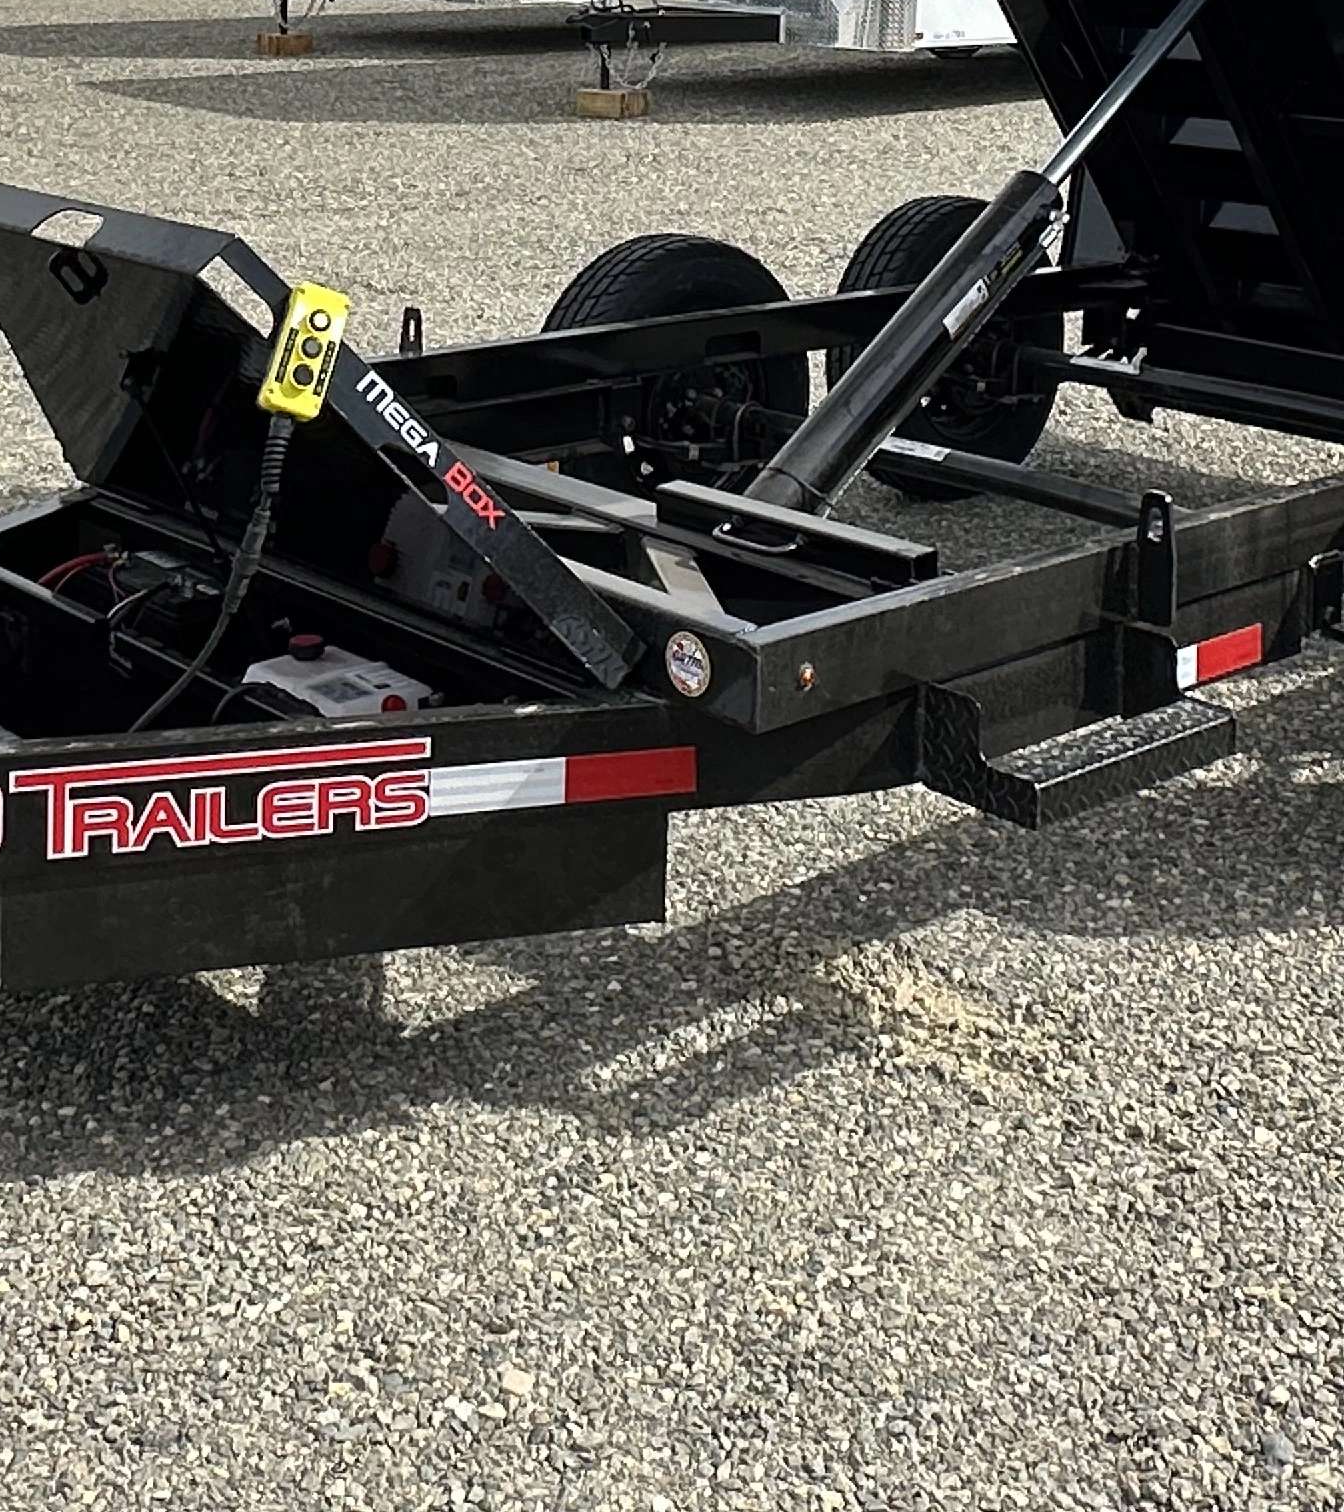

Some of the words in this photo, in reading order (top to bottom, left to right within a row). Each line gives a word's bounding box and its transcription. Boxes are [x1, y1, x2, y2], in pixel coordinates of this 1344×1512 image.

[355, 370, 440, 468] MEGA
[443, 460, 506, 530] BOX
[9, 737, 432, 861] TRAILERS
